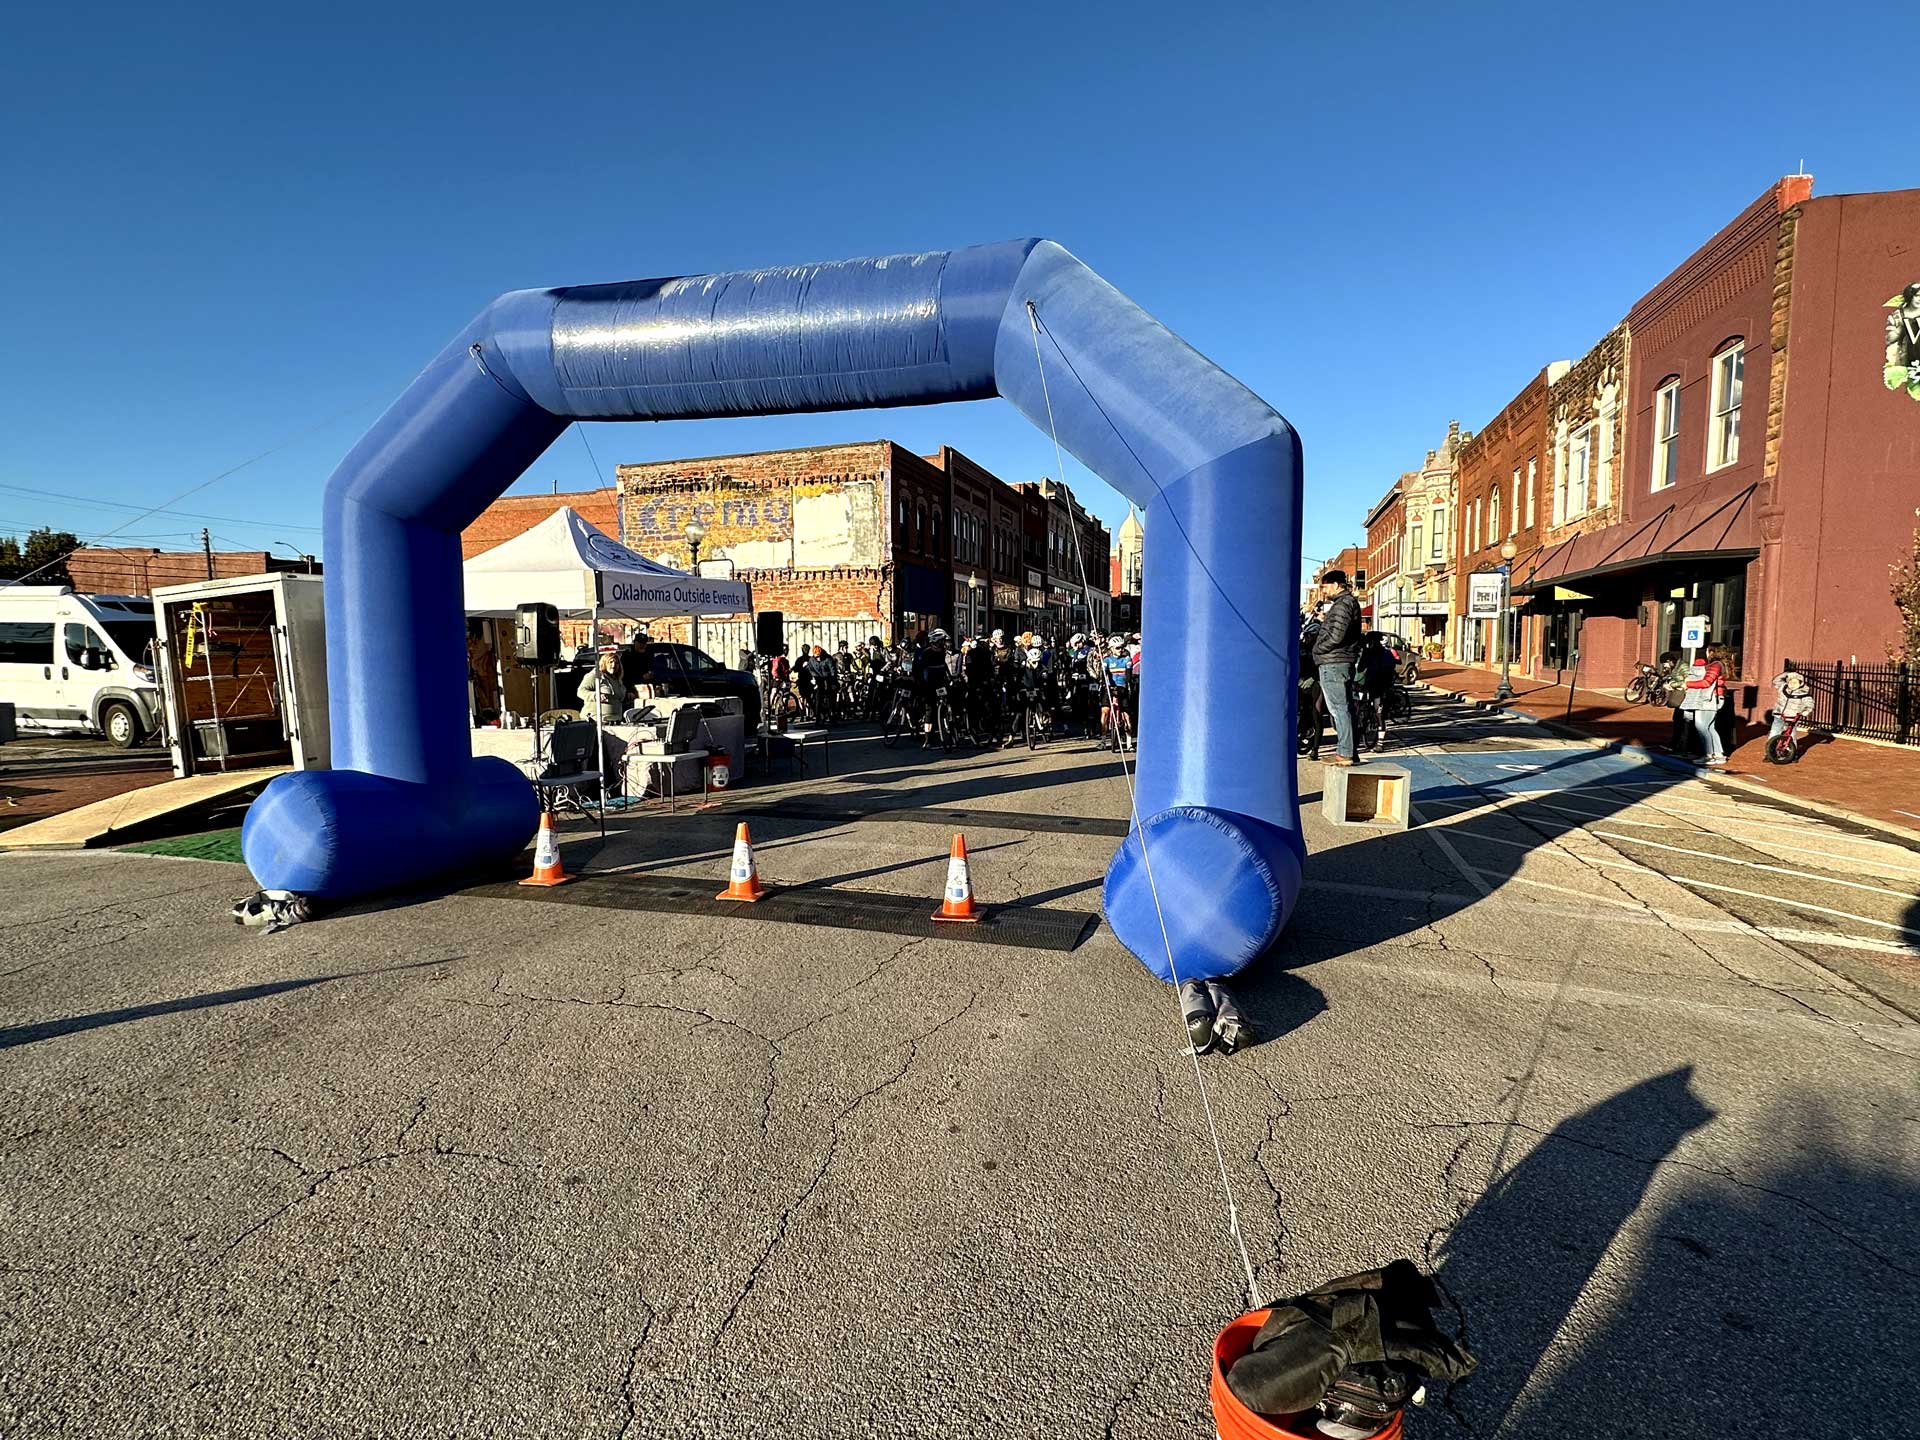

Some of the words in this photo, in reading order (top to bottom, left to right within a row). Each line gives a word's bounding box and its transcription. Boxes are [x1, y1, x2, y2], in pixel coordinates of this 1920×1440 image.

[612, 584, 671, 602] Oklahoma
[673, 587, 711, 604] Outside
[712, 591, 740, 606] Events
